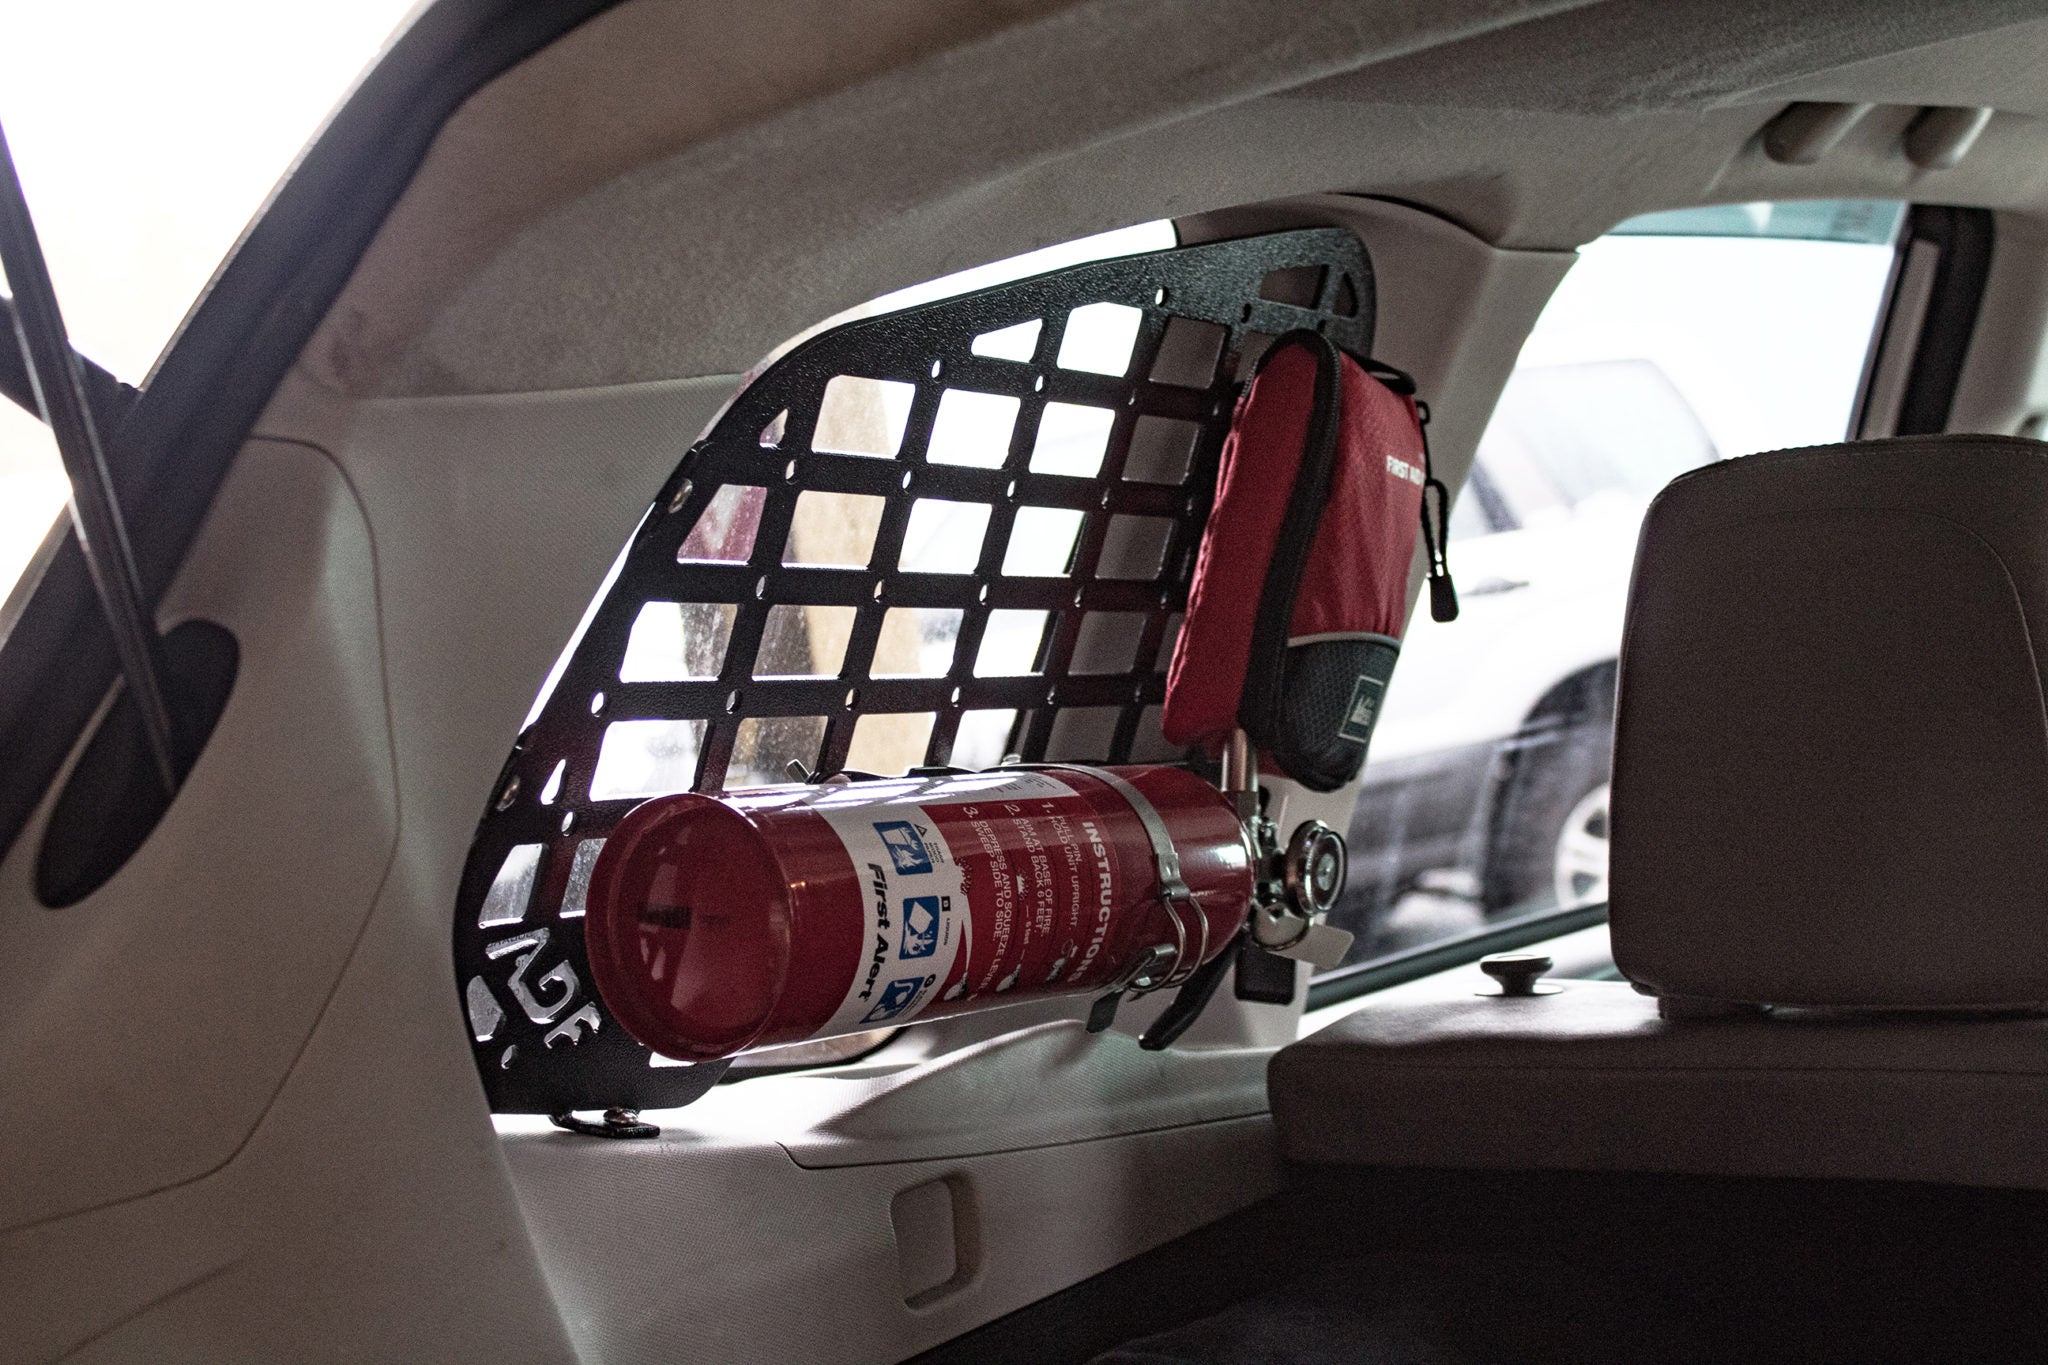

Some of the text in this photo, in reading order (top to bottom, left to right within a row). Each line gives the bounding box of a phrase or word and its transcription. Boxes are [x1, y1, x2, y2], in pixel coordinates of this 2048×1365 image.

[1386, 454, 1409, 480] FIRST
[962, 806, 979, 819] 3.
[1042, 802, 1054, 813] 1.
[1056, 816, 1075, 841] PULL
[971, 820, 995, 858] SWEEP
[979, 820, 1007, 870] DEPRESS
[990, 861, 1003, 888] SIDE
[1001, 872, 1012, 899] AND
[1003, 803, 1053, 937] 2. AIM AT BASE OF FIRE.
[1013, 818, 1046, 933] STAND BACK 6 FEET.
[1048, 816, 1080, 931] HOLD UNIT UPRIGHT.
[995, 891, 1005, 908] TO
[1066, 821, 1111, 982] INSTRUCTIONS
[858, 862, 890, 1000] First Alert
[996, 901, 1013, 957] SQUEEZE
